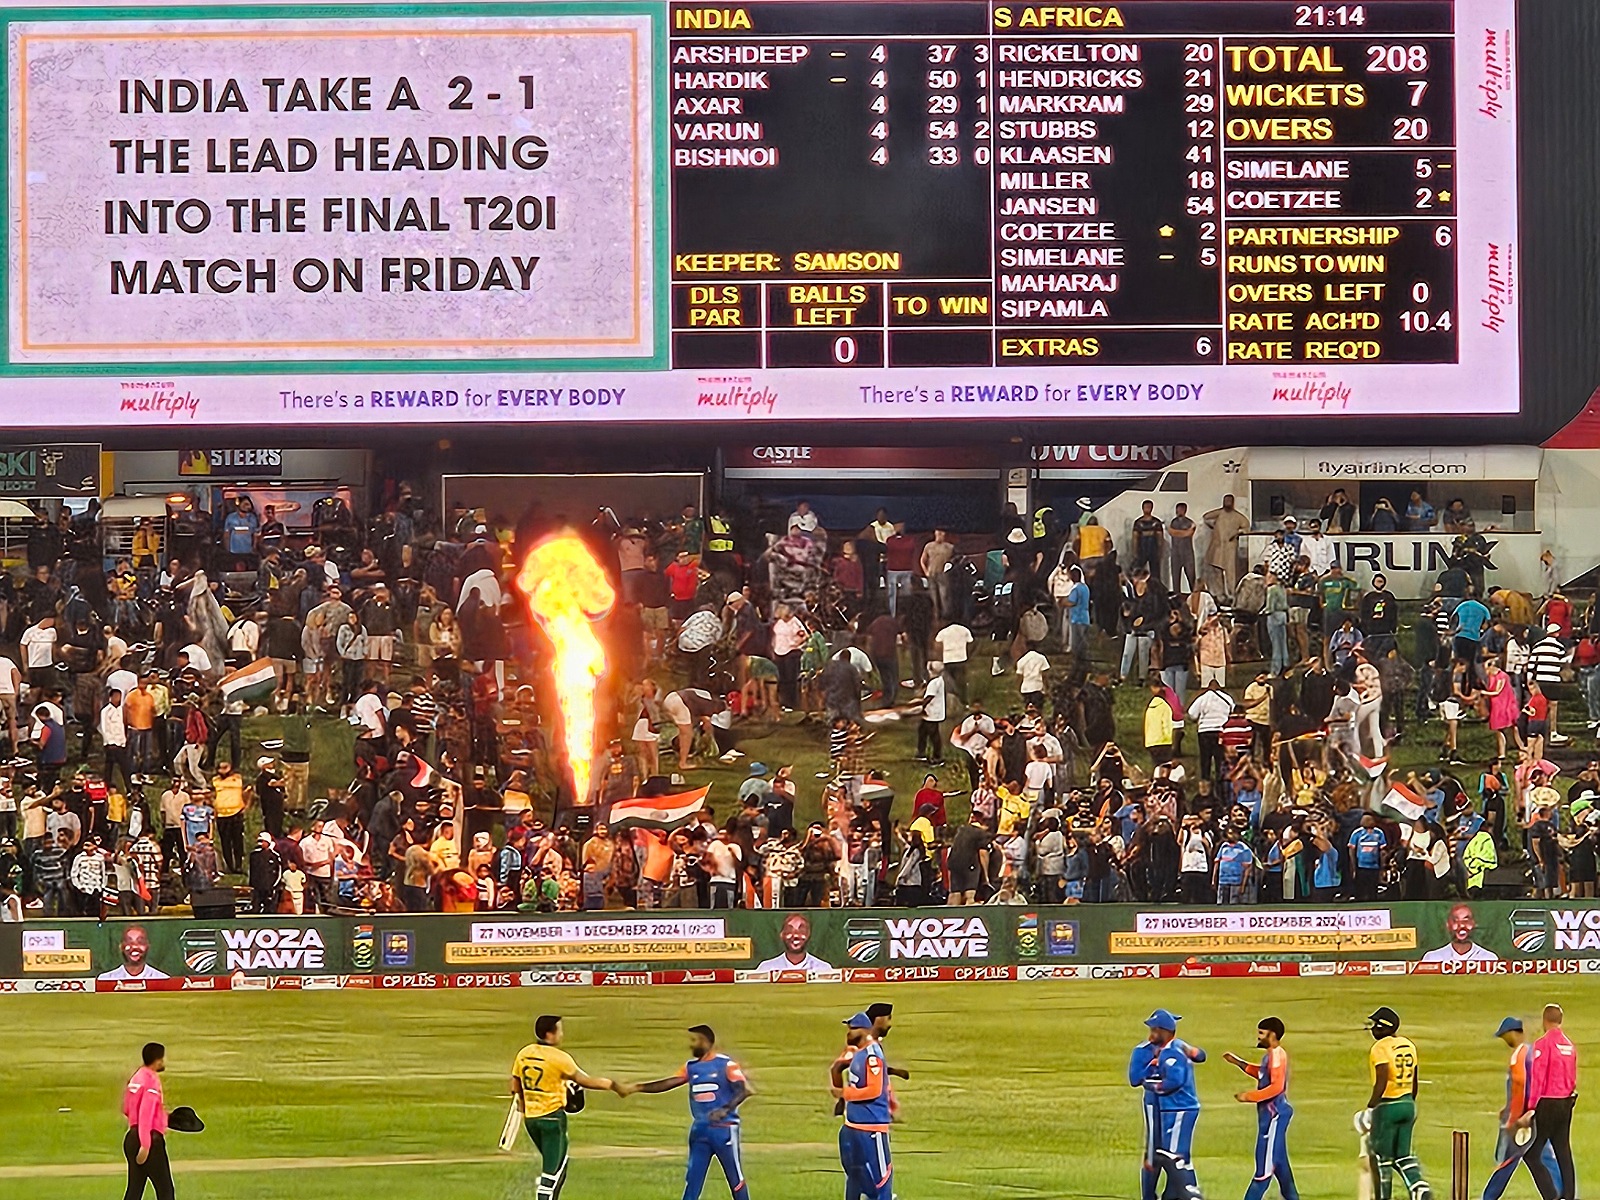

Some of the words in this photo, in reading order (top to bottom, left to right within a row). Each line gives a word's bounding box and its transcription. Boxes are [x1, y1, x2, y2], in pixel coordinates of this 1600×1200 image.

[676, 9, 752, 29] INDIA
[994, 8, 1012, 27] S
[1018, 8, 1124, 27] AFRICA
[1296, 6, 1365, 26] 21:14
[673, 46, 808, 64] ARSHDEEP
[870, 45, 886, 63] 4
[928, 45, 957, 63] 37
[975, 45, 989, 63] 3
[1000, 44, 1138, 62] RICKELTON
[1185, 43, 1213, 62] 20
[1225, 46, 1344, 72] TOTAL
[1366, 45, 1427, 72] 208
[674, 72, 767, 90] HARDIK
[870, 71, 887, 88] 4
[928, 70, 957, 88] 50
[977, 70, 986, 88] 1
[1000, 69, 1143, 88] HENDRICKS
[1185, 69, 1211, 87] 21
[1478, 28, 1503, 119] multiply
[119, 78, 249, 114] INDIA
[262, 76, 372, 113] TAKE
[386, 76, 421, 111] A
[447, 75, 473, 110] 2
[518, 75, 534, 110] 1
[1000, 95, 1123, 113] MARKRAM
[1185, 94, 1214, 113] 29
[1226, 84, 1365, 106] WICKETS
[1407, 81, 1427, 107] 7
[674, 97, 741, 115] AXAR
[870, 96, 887, 114] 4
[928, 96, 957, 114] 29
[976, 96, 986, 113] 1
[674, 123, 760, 140] VARUN
[871, 122, 887, 139] 4
[929, 121, 957, 139] 54
[975, 121, 990, 139] 2
[1000, 120, 1097, 139] STUBBS
[1187, 119, 1215, 138] 12
[1227, 118, 1333, 141] OVERS
[1393, 118, 1428, 140] 20
[109, 138, 190, 174] THE
[206, 138, 318, 173] LEAD
[335, 135, 549, 172] HEADING
[675, 148, 775, 166] BISHNOI
[871, 147, 887, 165] 4
[929, 147, 958, 165] 33
[975, 147, 990, 165] 0
[1000, 146, 1111, 164] KLAASEN
[1185, 145, 1212, 163] 41
[1227, 161, 1350, 179] SIMELANE
[1416, 159, 1432, 178] 5
[1001, 171, 1090, 190] MILLER
[1188, 171, 1215, 189] 18
[1001, 197, 1096, 216] JANSEN
[1187, 197, 1215, 215] 54
[1227, 190, 1341, 209] COETZEE
[1416, 188, 1432, 208] 2
[104, 198, 211, 235] INTO
[226, 198, 306, 233] THE
[323, 196, 450, 233] FINAL
[463, 195, 556, 231] T20I
[1001, 223, 1116, 241] COETZEE
[1200, 222, 1216, 240] 2
[1228, 226, 1400, 246] PARTNERSHIP
[1435, 225, 1452, 246] 6
[675, 254, 781, 272] KEEPER:
[794, 253, 900, 272] SAMSON
[1001, 248, 1125, 267] SIMELANE
[1201, 248, 1216, 266] 5
[1228, 255, 1297, 273] RUNS
[1300, 255, 1335, 273] TO
[1338, 254, 1385, 273] WIN
[110, 258, 276, 295] MATCH
[292, 257, 363, 293] ON
[381, 256, 541, 293] FRIDAY
[1001, 274, 1117, 292] MAHARAJ
[690, 287, 739, 304] DLS
[790, 286, 867, 303] BALLS
[1228, 284, 1313, 302] OVERS
[1325, 284, 1386, 301] LEFT
[1412, 282, 1429, 303] 0
[1481, 243, 1505, 333] multiply
[892, 297, 927, 315] TO
[939, 297, 988, 315] WIN
[1001, 300, 1108, 318] SIPAMLA
[690, 308, 741, 326] PAR
[796, 308, 857, 325] LEFT
[1229, 313, 1294, 330] RATE
[1305, 312, 1380, 330] ACH'D
[1399, 310, 1452, 332] 10.4
[835, 337, 855, 363] 0
[1002, 338, 1099, 356] EXTRAS
[1196, 337, 1212, 356] 6
[1228, 342, 1293, 359] RATE
[1305, 341, 1381, 359] REQ'D
[279, 390, 348, 408] There's
[354, 395, 364, 407] a
[371, 390, 459, 407] REWARD
[465, 388, 492, 406] for
[497, 389, 563, 406] EVERY
[569, 388, 626, 405] BODY
[698, 386, 778, 414] multiply
[859, 385, 929, 403] There's
[934, 390, 945, 402] a
[951, 385, 1039, 402] REWARD
[1044, 384, 1071, 401] for
[1077, 384, 1142, 401] EVERY
[1149, 384, 1204, 400] BODY
[1272, 381, 1351, 409] multiply
[120, 391, 200, 419] multiply
[753, 446, 812, 459] CASTLE
[1318, 461, 1468, 477] flyairlink.com
[1332, 541, 1499, 572] IRLINK
[497, 926, 563, 939] NOVEMBER
[584, 925, 648, 937] DECEMBER
[884, 917, 989, 938] WOZA
[1145, 918, 1159, 929] 27
[1162, 917, 1228, 929] NOVEMBER
[1250, 916, 1313, 928] DECEMBER
[220, 928, 325, 949] WOZA
[889, 938, 989, 959] NAWE
[226, 949, 325, 970] NAWE
[1441, 960, 1463, 974] CP
[1466, 960, 1507, 974] PLUS
[1512, 960, 1533, 974] CP
[1536, 960, 1579, 974] PLUS
[383, 975, 401, 987] CP
[402, 973, 437, 987] PLUS
[456, 974, 474, 987] CP
[476, 974, 512, 987] PLUS
[884, 967, 903, 980] CP
[904, 966, 940, 979] PLUS
[955, 966, 973, 980] CP
